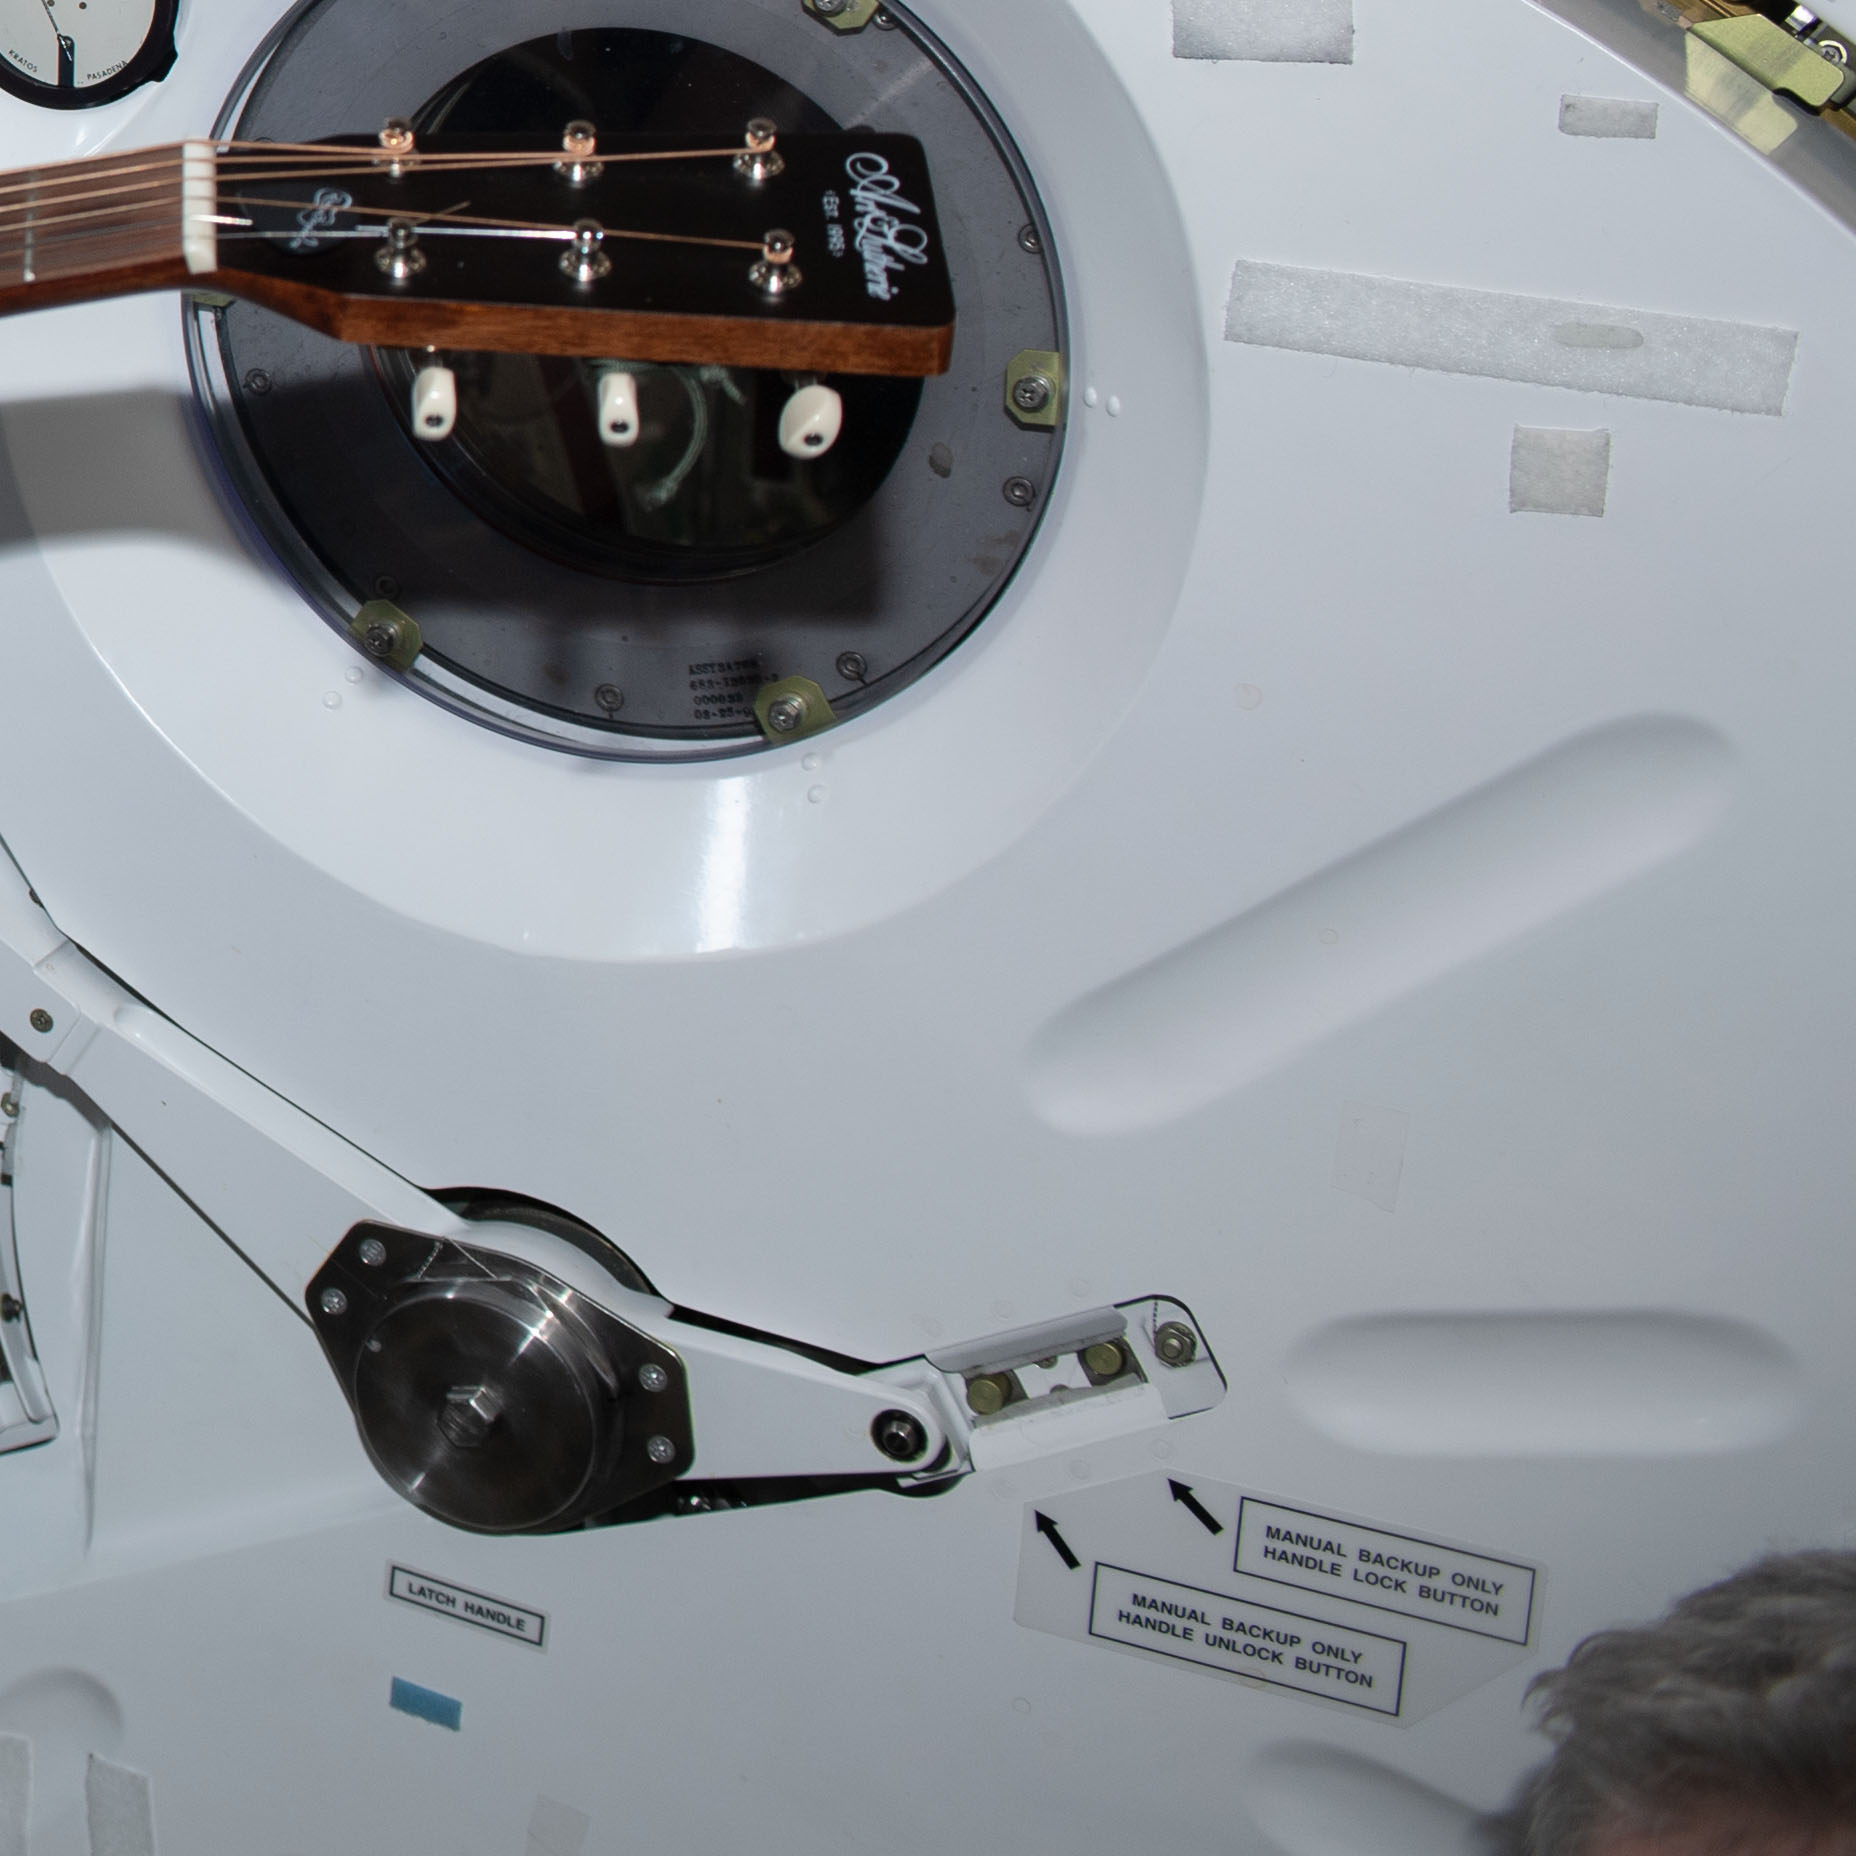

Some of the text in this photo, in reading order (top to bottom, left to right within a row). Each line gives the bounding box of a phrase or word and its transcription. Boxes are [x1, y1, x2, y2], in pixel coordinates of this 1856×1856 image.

[8, 49, 38, 73] KRATOS
[86, 60, 128, 81] PASADENA
[1263, 1544, 1501, 1619] HANDLE LOCK BUTTON
[1265, 1524, 1505, 1599] MANUAL BACKUP ONLY
[406, 1580, 527, 1634] LATCH HANDLE
[1131, 1592, 1365, 1667] MANUAL BACKUP ONLY
[1118, 1608, 1375, 1690] HANDLE UNLOCK BUTTON
